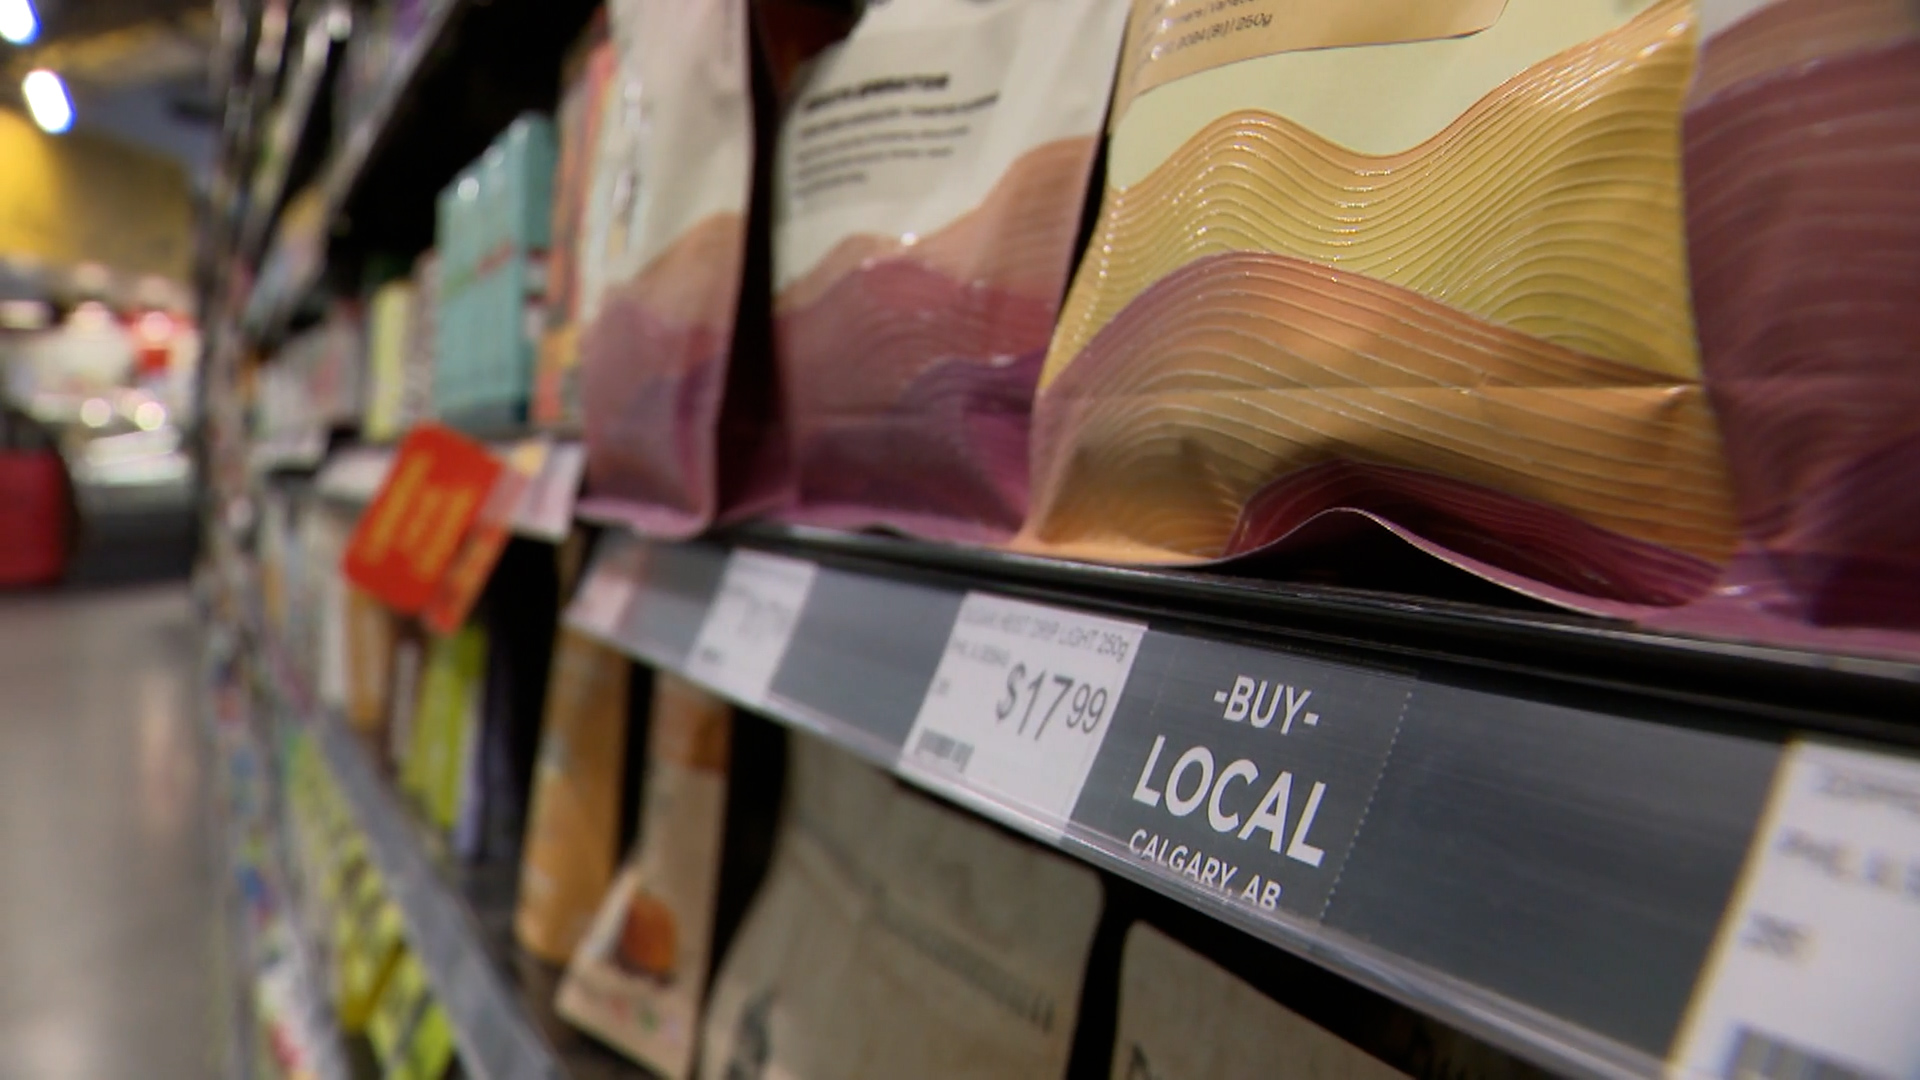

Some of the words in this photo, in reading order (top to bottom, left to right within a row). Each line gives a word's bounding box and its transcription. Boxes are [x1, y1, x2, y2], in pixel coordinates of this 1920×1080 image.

[1132, 734, 1327, 869] LOCAL
[1129, 828, 1239, 897] CALGARY,
[1240, 874, 1283, 911] AB
